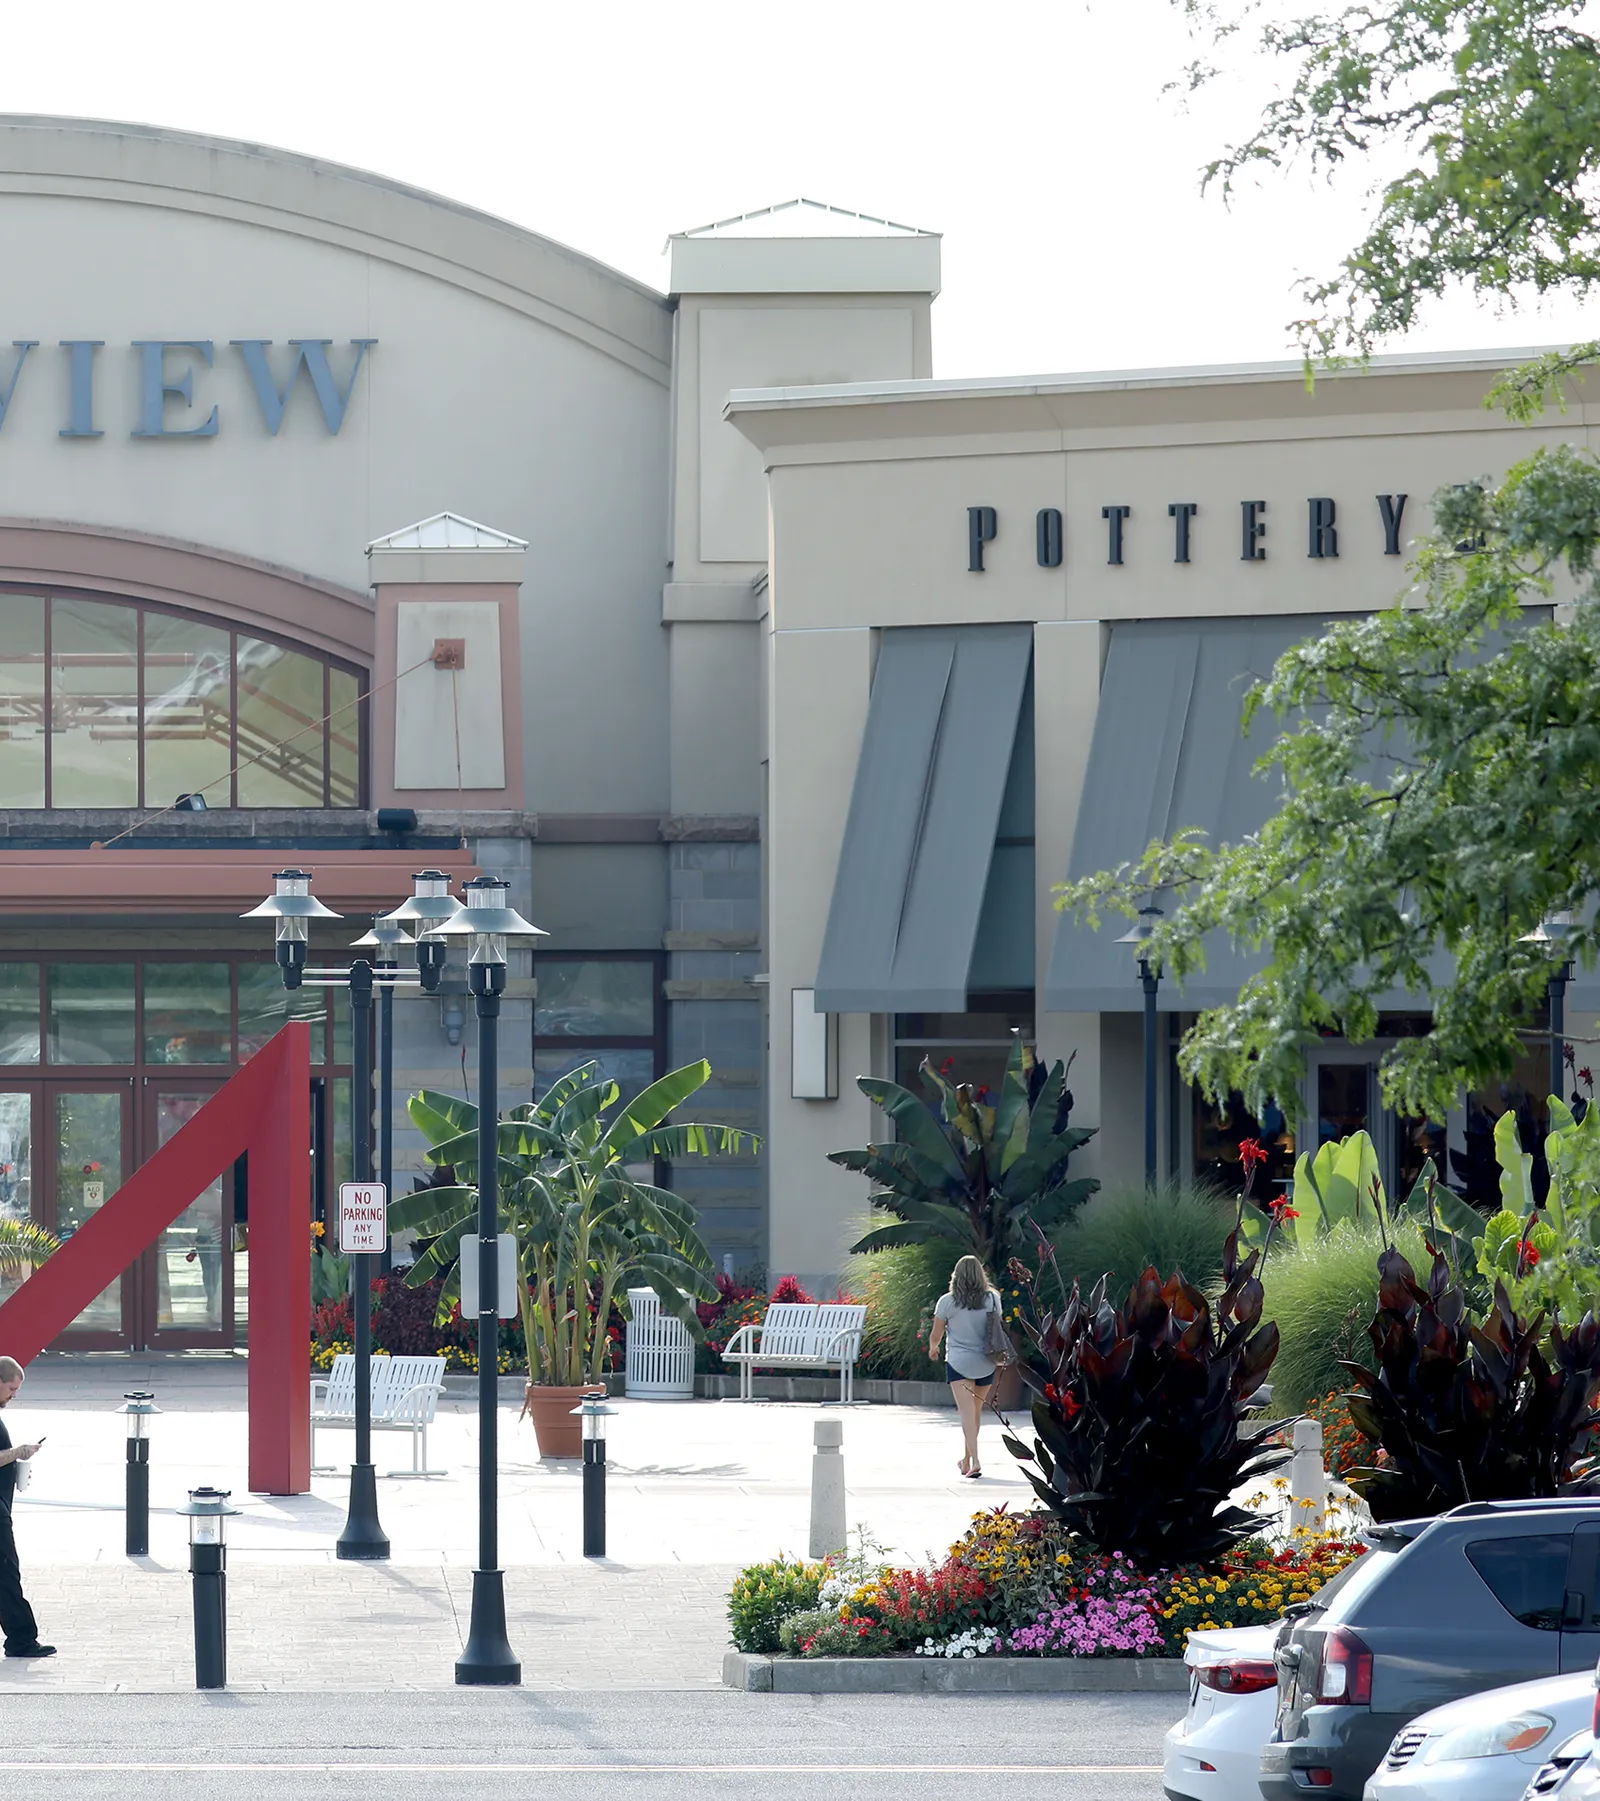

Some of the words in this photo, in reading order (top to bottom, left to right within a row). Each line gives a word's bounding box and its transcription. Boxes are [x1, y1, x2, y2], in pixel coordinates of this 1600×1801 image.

[966, 493, 1409, 572] POTTERY
[354, 1191, 372, 1205] NO
[343, 1207, 383, 1221] PARKING
[353, 1223, 372, 1233] ANY
[352, 1235, 374, 1245] TIME
